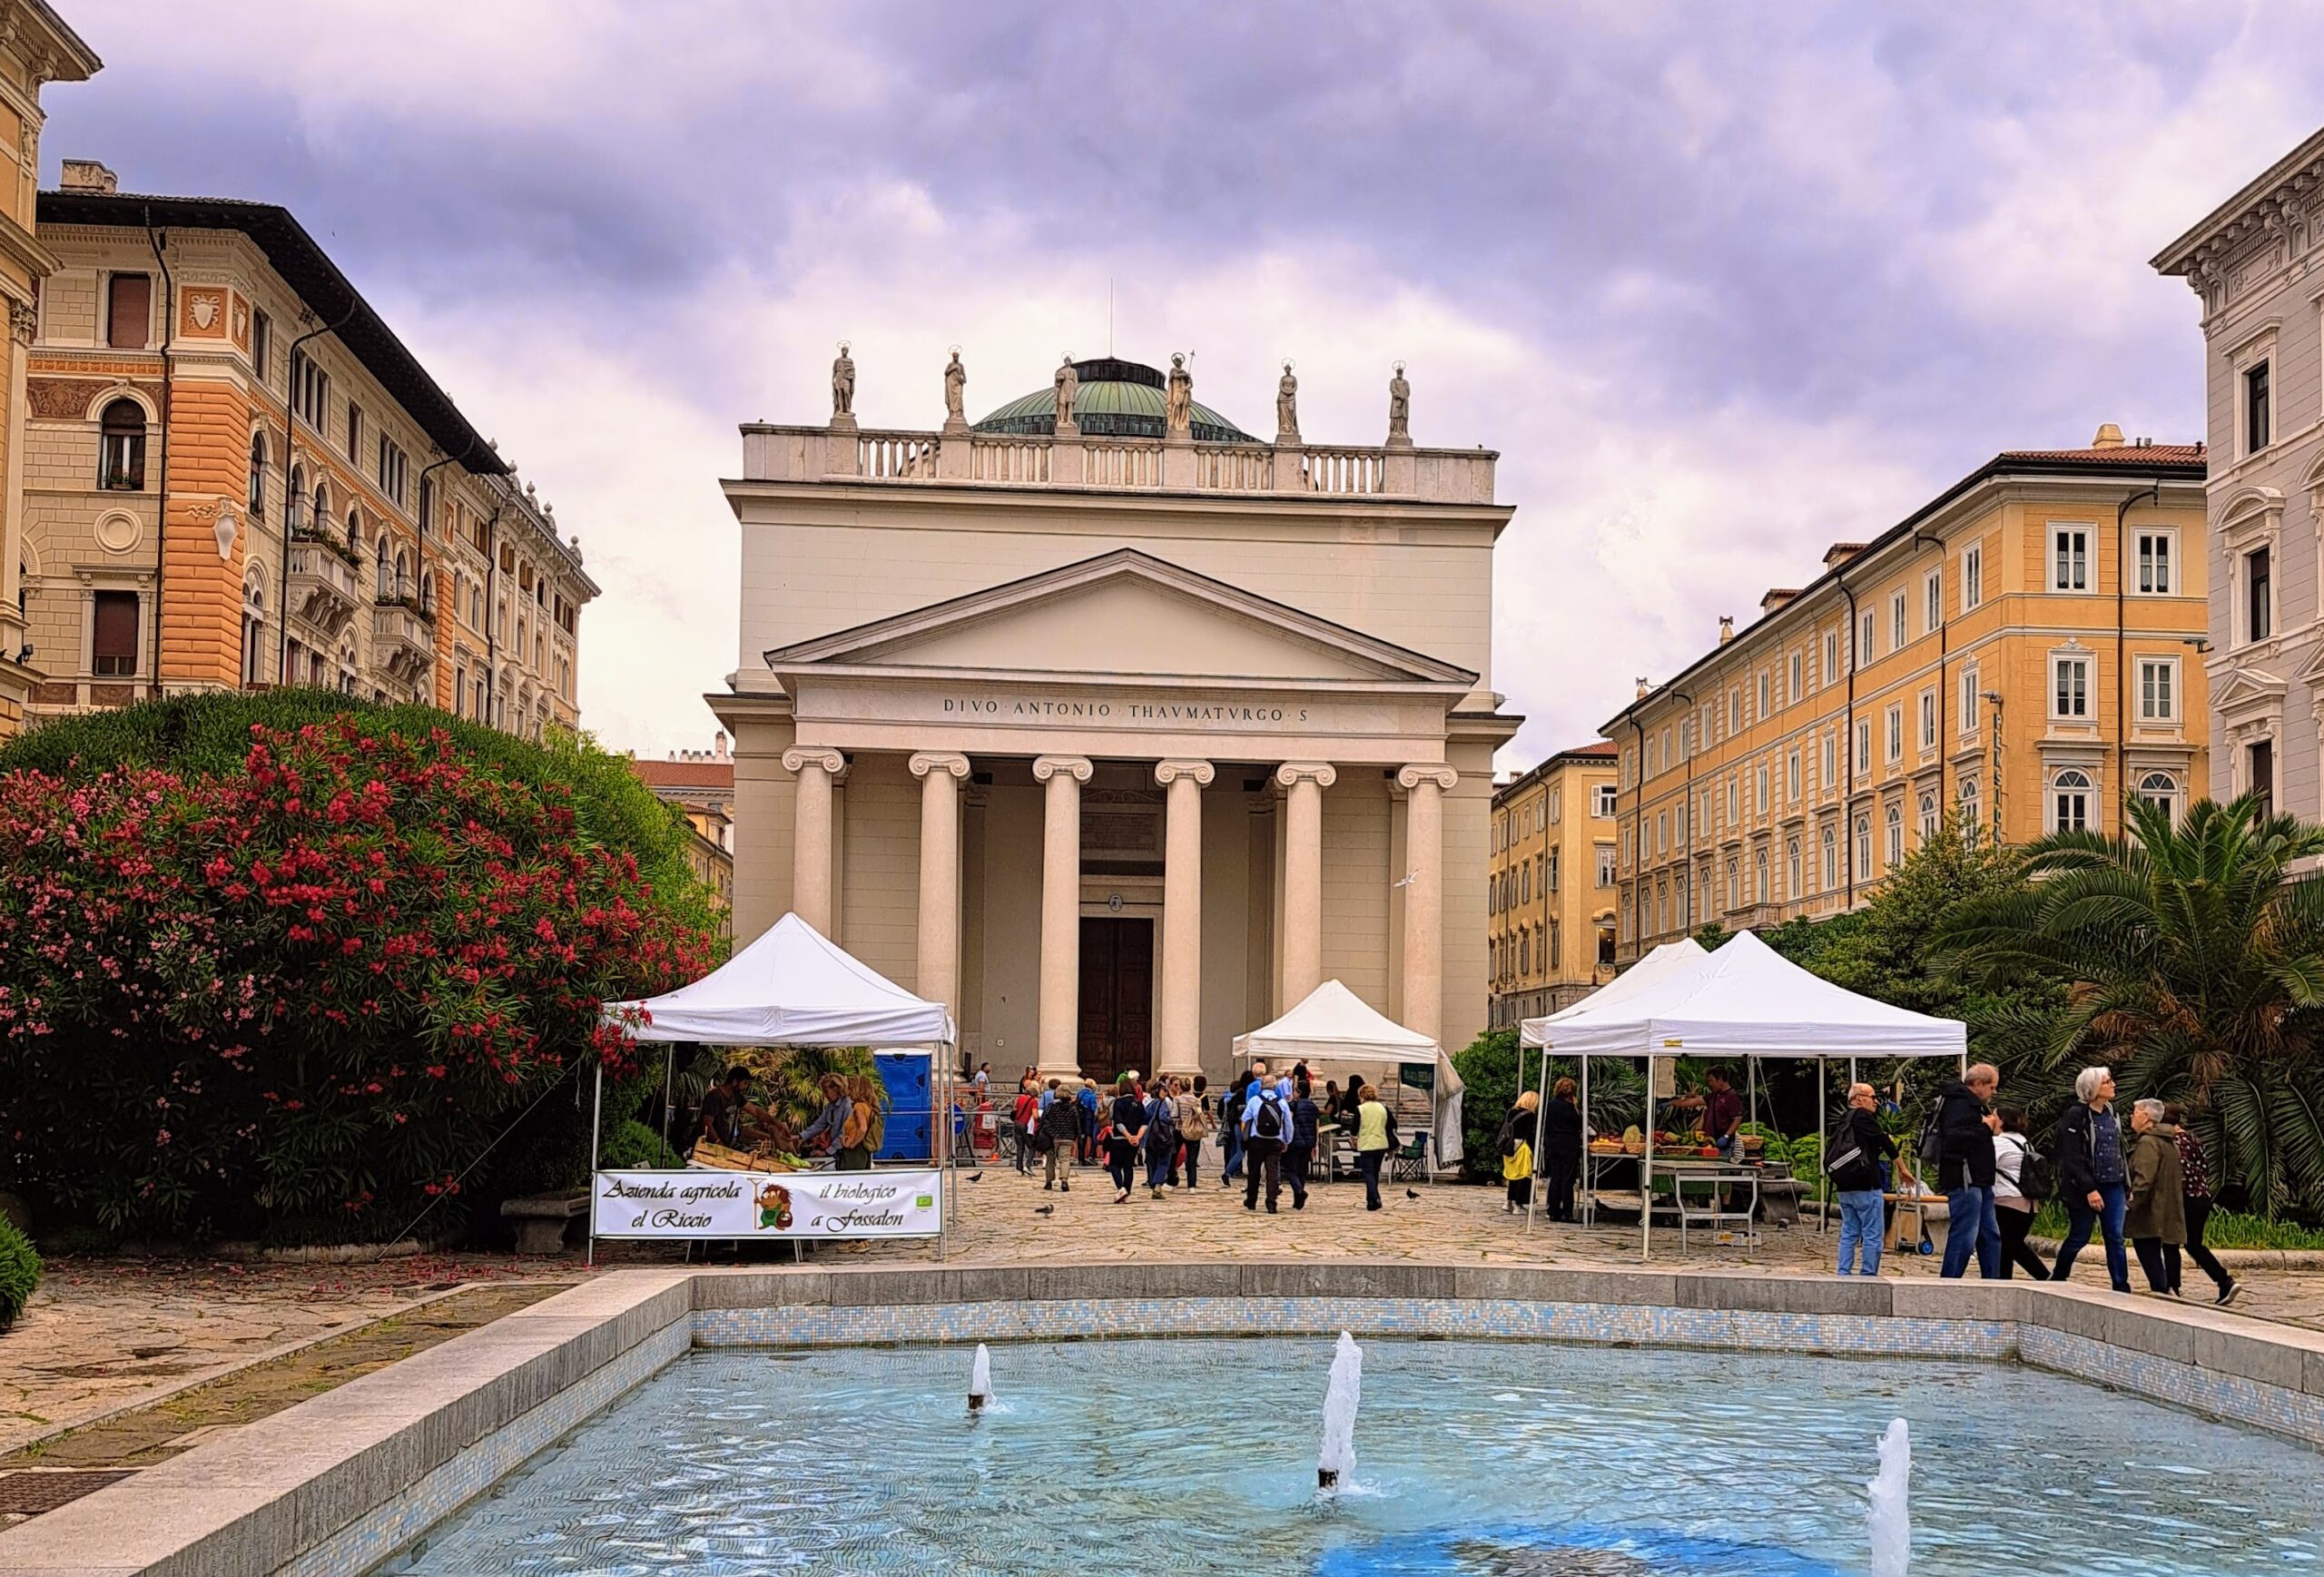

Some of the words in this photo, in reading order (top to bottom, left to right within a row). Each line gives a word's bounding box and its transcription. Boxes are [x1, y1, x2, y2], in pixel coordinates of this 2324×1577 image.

[944, 698, 998, 714] DIVO
[1013, 702, 1110, 716] ANTONIO
[1128, 705, 1283, 722] THAVMATVRGO
[602, 1178, 677, 1198] Azienda
[679, 1179, 743, 1206] agricola
[819, 1183, 832, 1199] il
[833, 1181, 898, 1206] biologico
[631, 1208, 649, 1227] el
[651, 1208, 713, 1228] Riccio
[811, 1215, 823, 1227] a
[826, 1208, 904, 1233] Fossalon
